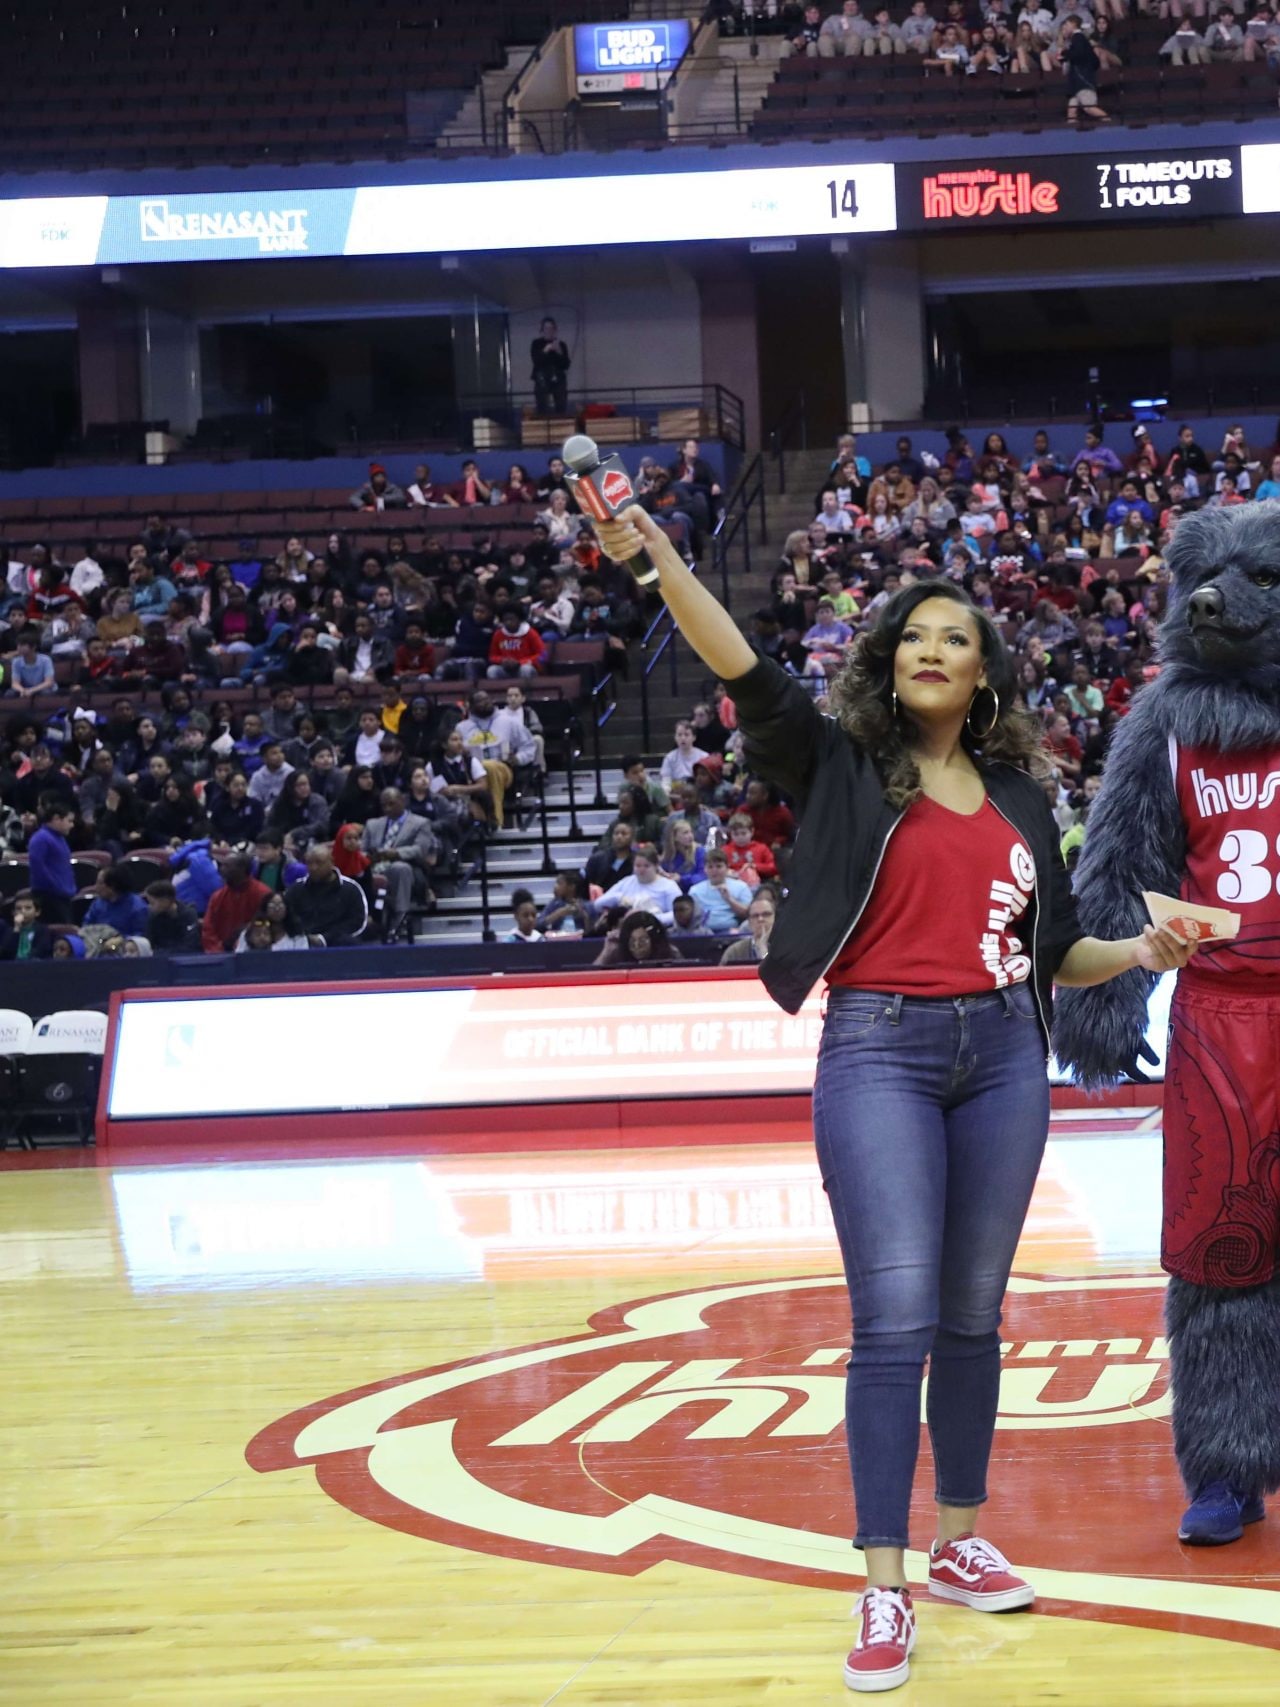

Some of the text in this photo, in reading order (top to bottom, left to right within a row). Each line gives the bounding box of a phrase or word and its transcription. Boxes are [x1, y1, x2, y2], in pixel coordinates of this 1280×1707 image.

[607, 29, 656, 48] BUD
[599, 45, 665, 66] LIGHT
[1096, 158, 1233, 186] 7 TIMEOUTS
[826, 179, 859, 218] 14
[923, 172, 1060, 218] hustle
[1099, 184, 1191, 209] 1 FOULS
[167, 209, 308, 236] RENASANT
[259, 233, 309, 252] BANK
[503, 1025, 613, 1058] OFFICIAL
[617, 1023, 686, 1054] BANK
[691, 1021, 723, 1051] OF
[727, 1020, 778, 1051] THE
